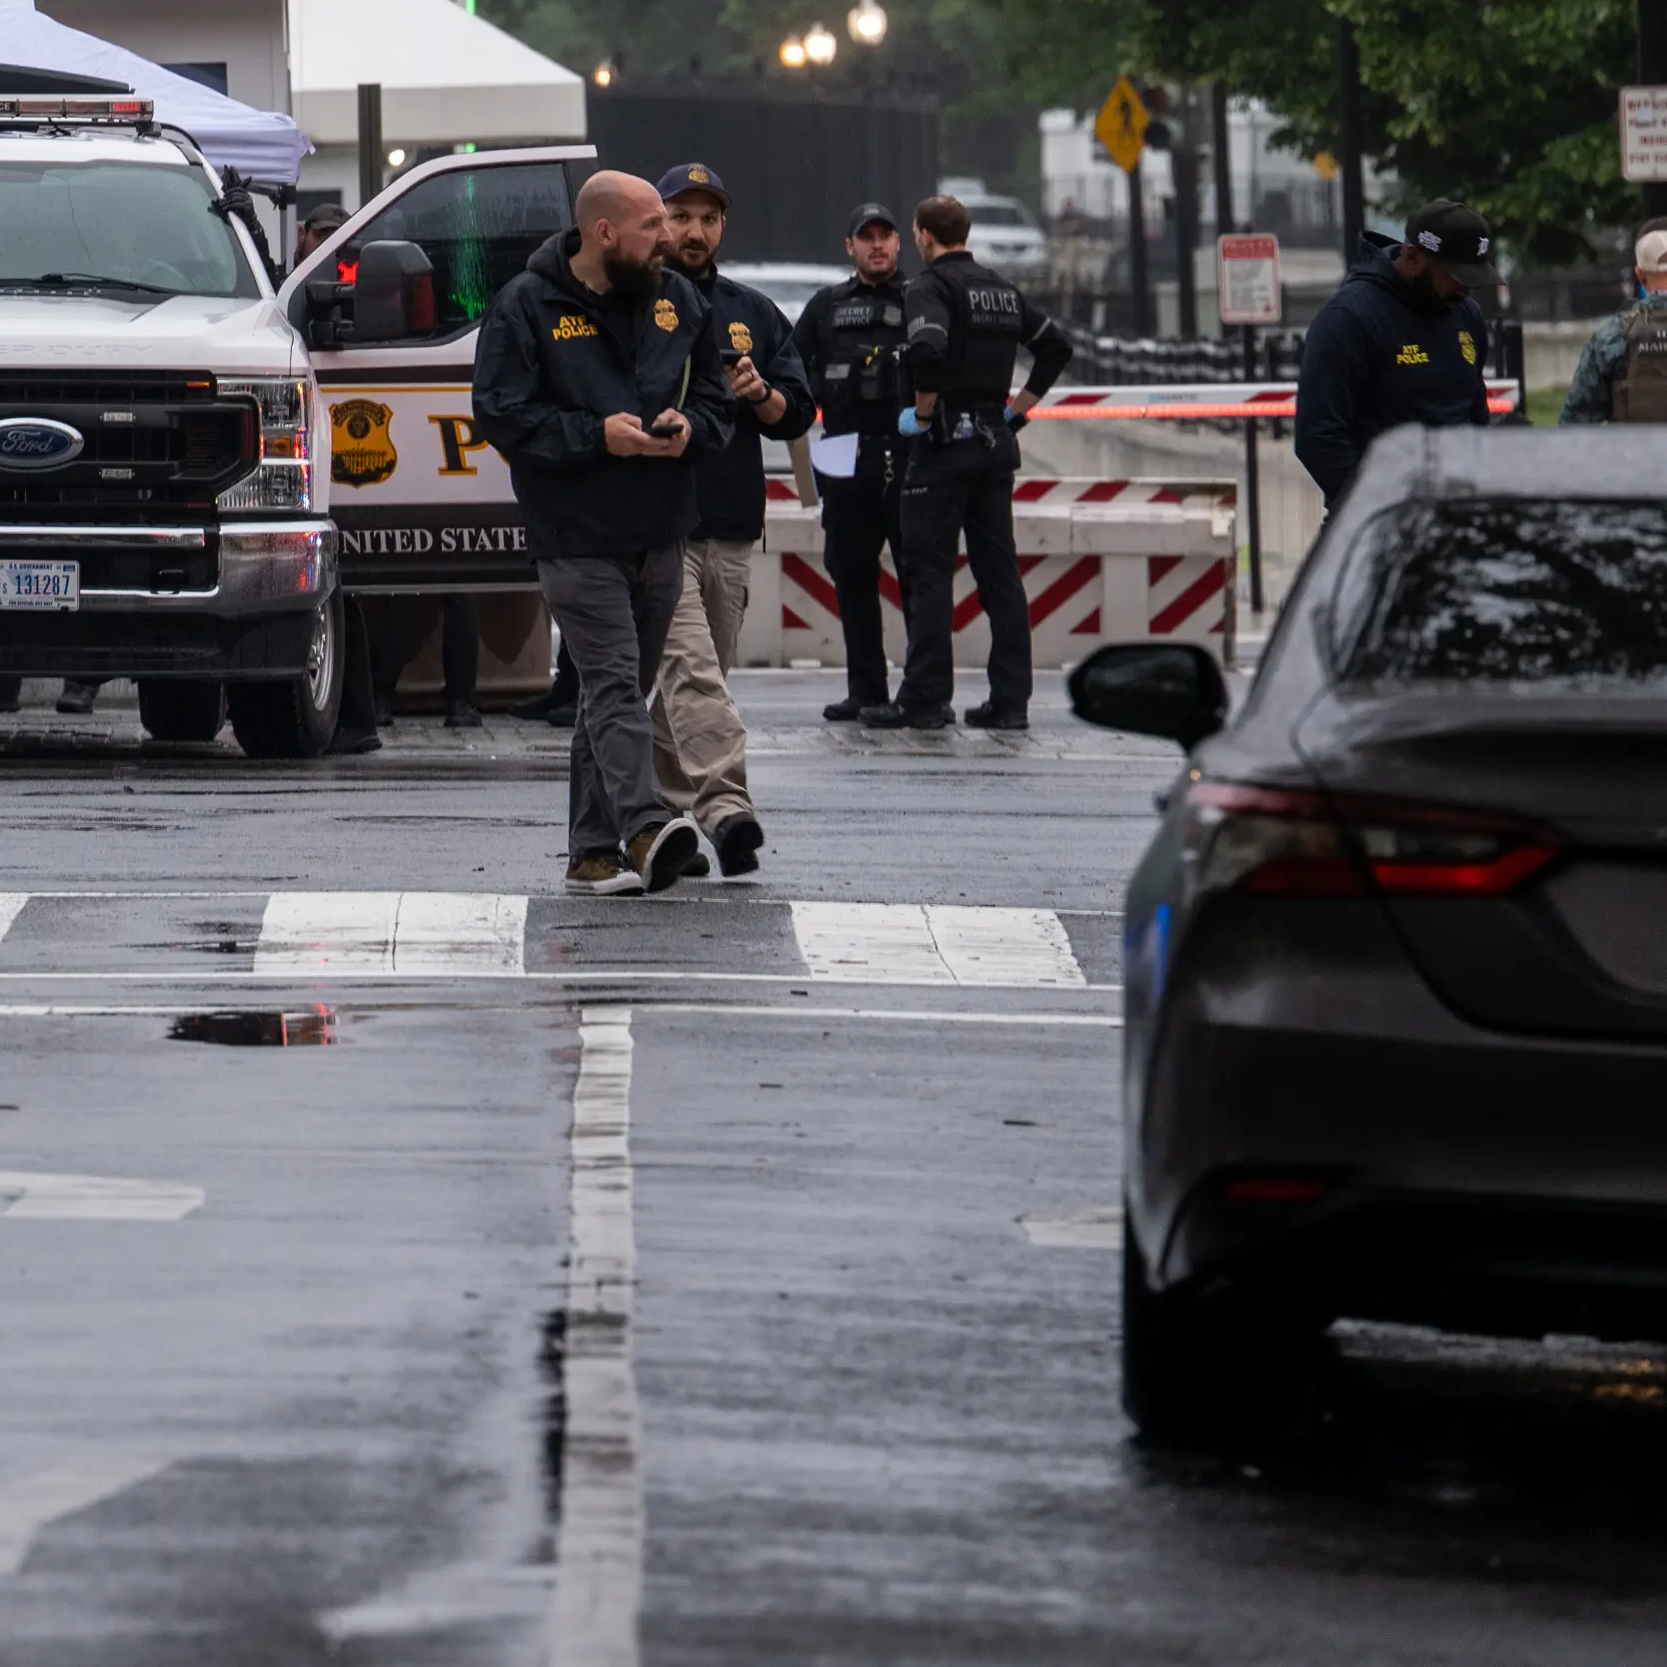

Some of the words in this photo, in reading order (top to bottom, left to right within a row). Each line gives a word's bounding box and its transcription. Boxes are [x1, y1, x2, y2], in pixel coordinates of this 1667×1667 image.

[969, 290, 1020, 314] POLICE
[559, 315, 586, 329] ATF
[552, 324, 599, 341] POLICE
[1396, 351, 1430, 365] POLICE
[1402, 344, 1420, 354] ATF
[2, 429, 55, 454] Ford
[338, 528, 439, 555] NITED
[15, 574, 71, 595] 131287
